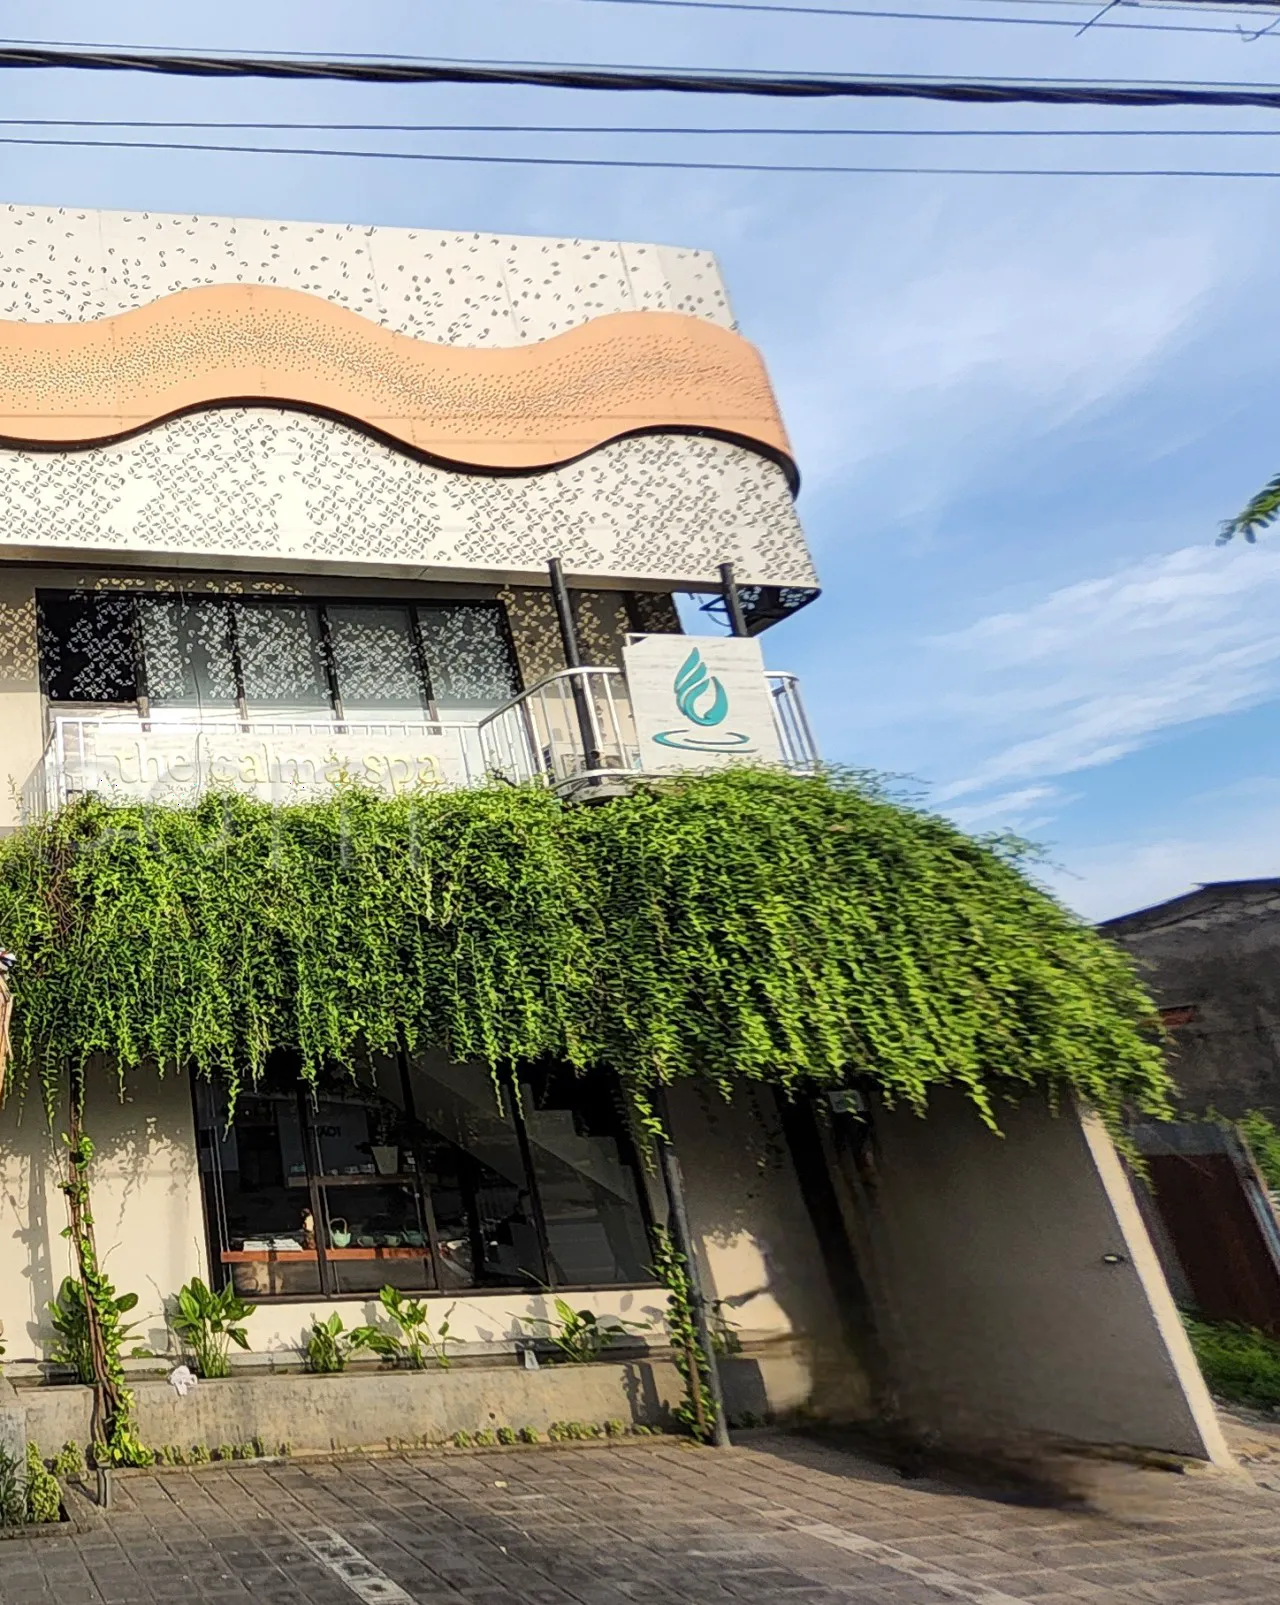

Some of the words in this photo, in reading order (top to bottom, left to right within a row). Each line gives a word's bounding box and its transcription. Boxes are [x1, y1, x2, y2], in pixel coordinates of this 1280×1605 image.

[111, 741, 195, 784] the
[208, 742, 351, 785] calma
[360, 754, 447, 797] spa
